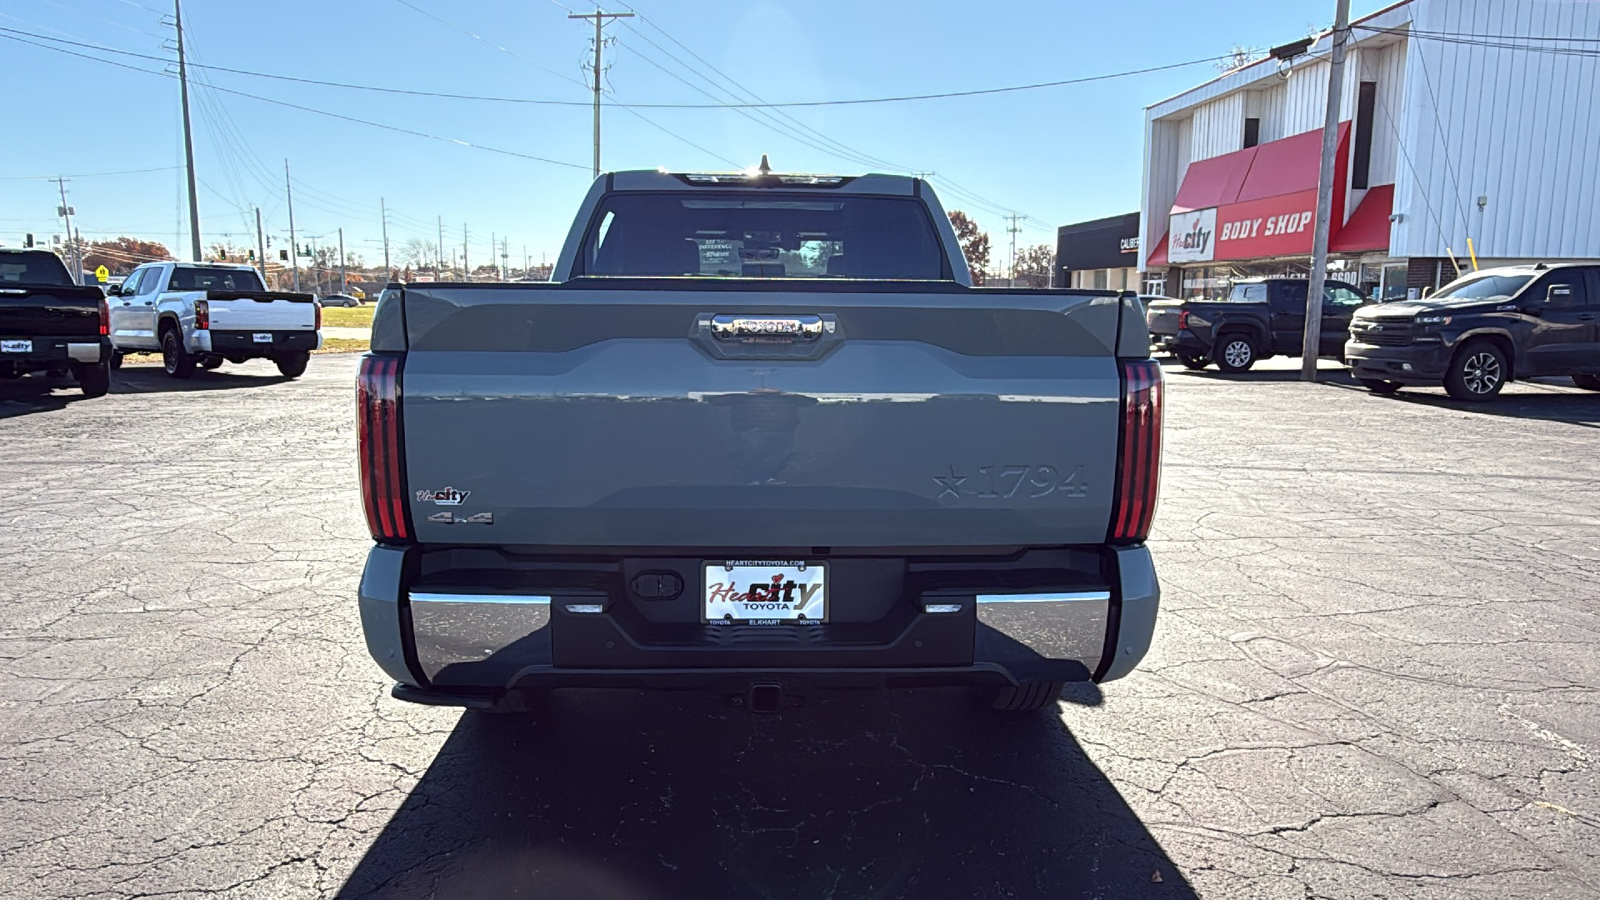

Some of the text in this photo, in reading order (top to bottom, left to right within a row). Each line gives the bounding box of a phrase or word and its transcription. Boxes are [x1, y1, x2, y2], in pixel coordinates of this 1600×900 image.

[1220, 211, 1312, 241] BODY SHOP
[1183, 226, 1211, 254] city
[742, 320, 797, 334] TOYOTA
[977, 464, 1089, 499] 1794
[434, 486, 471, 504] city
[427, 511, 493, 523] 4x4
[708, 577, 823, 611] Heart city
[743, 603, 790, 611] TOYOTA
[749, 619, 781, 627] ELKHART
